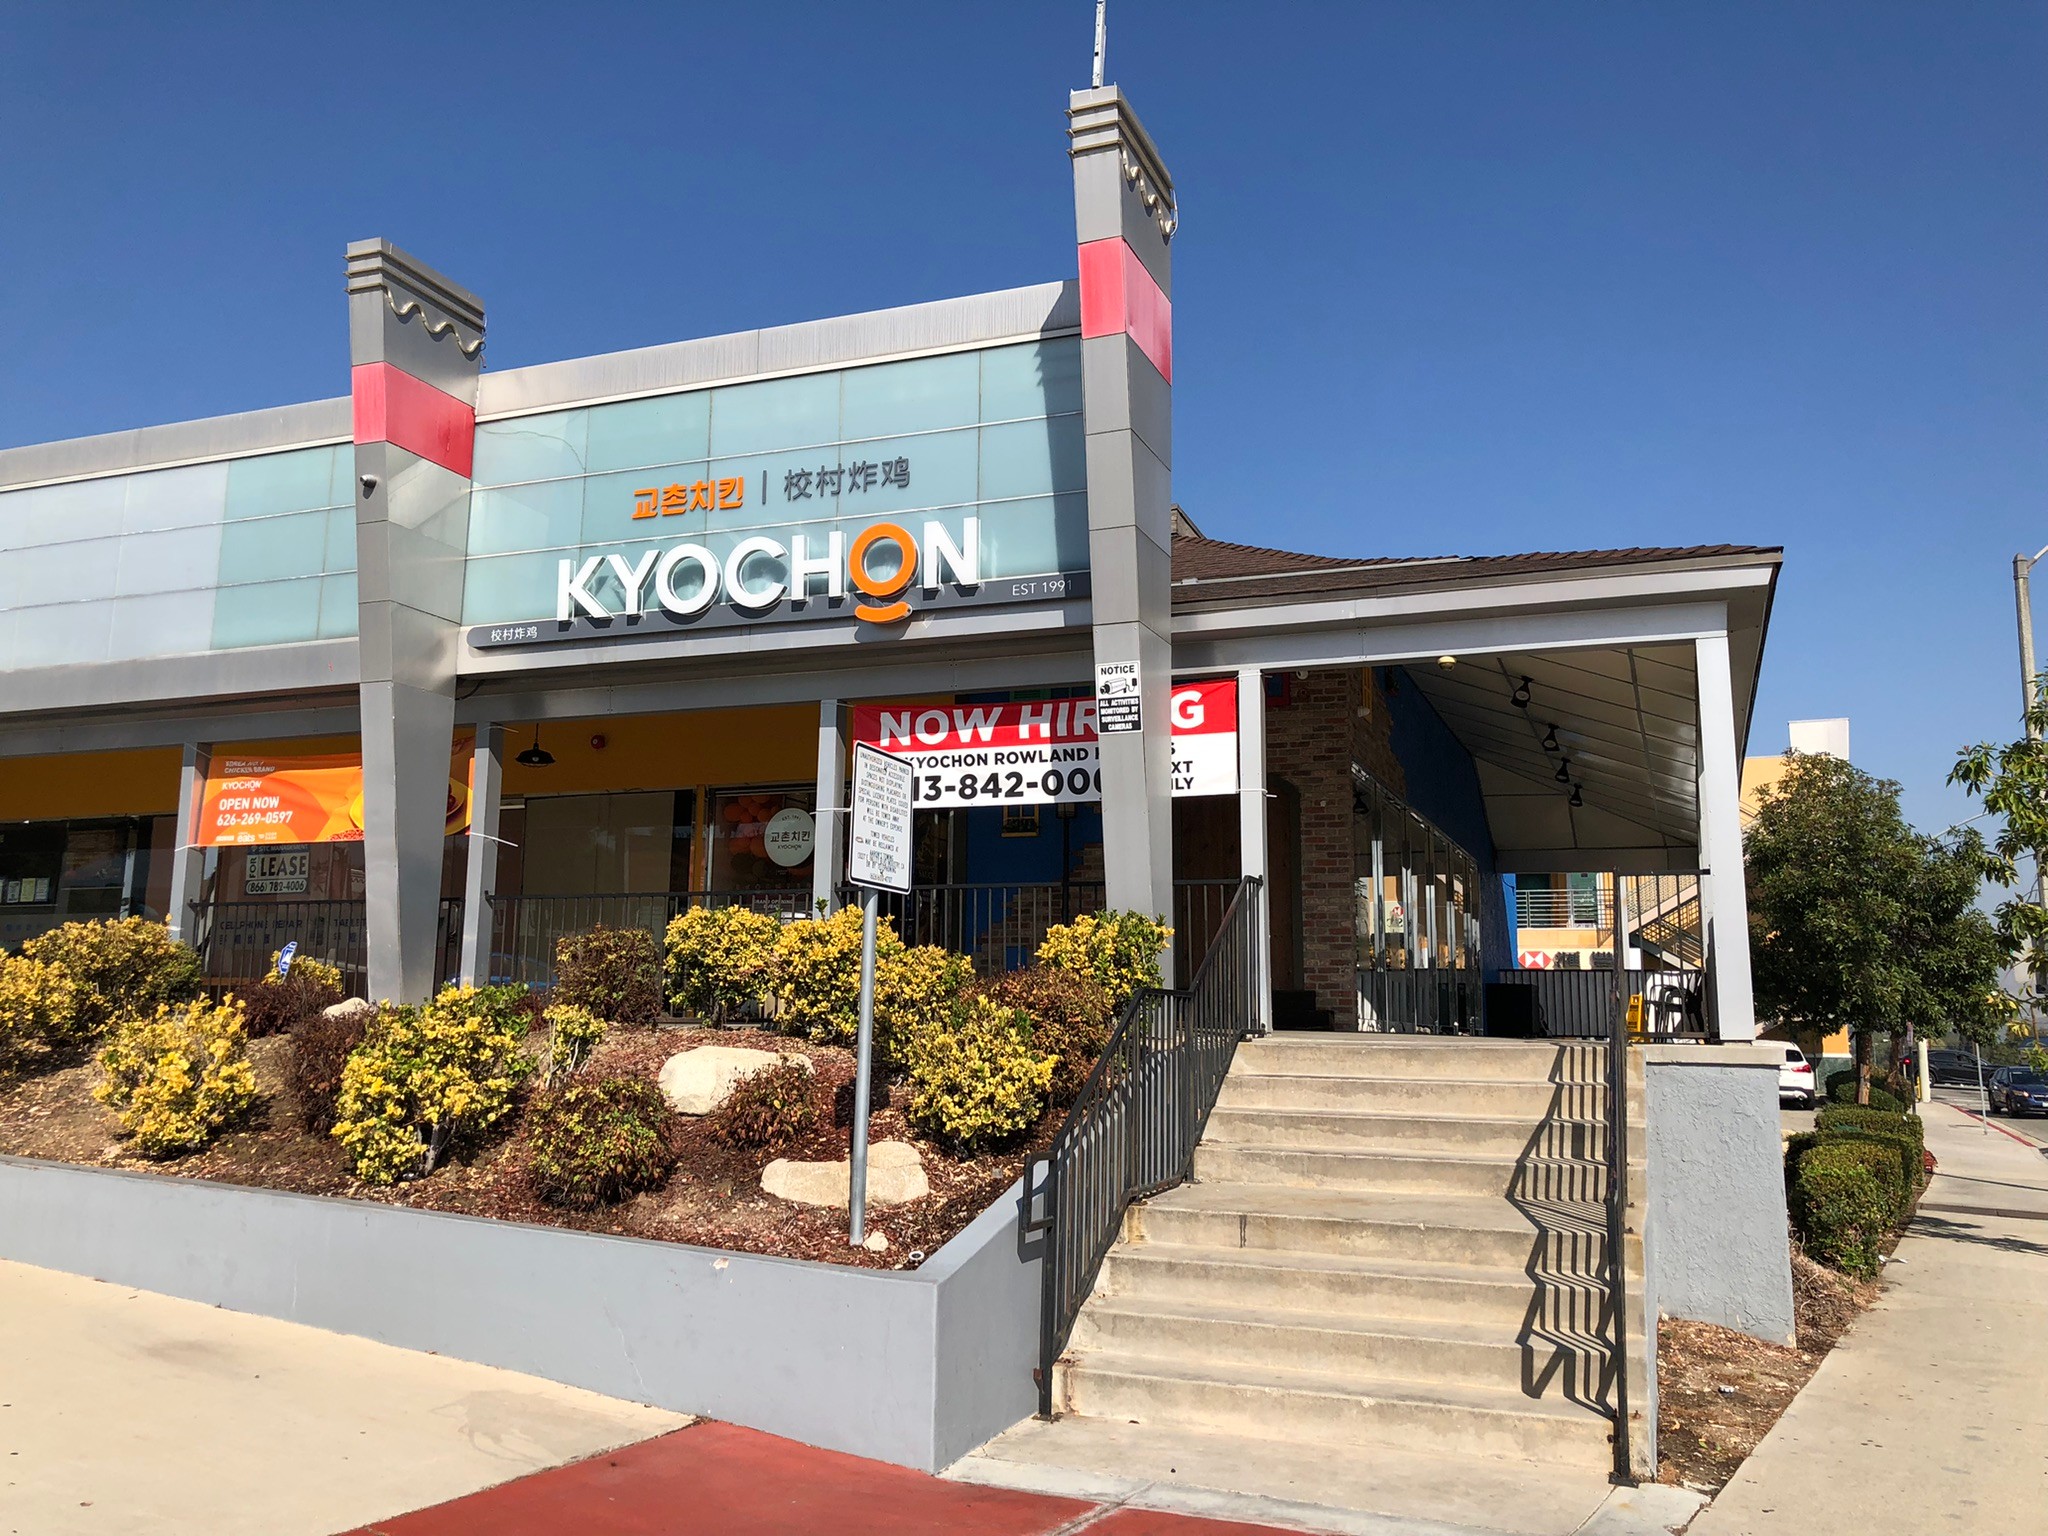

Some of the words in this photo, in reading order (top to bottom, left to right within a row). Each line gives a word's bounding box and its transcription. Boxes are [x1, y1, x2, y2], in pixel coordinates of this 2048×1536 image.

[784, 456, 910, 501] 校村炸鸡
[632, 476, 744, 519] 교촌치킨
[556, 516, 981, 623] KYOCHON
[1012, 583, 1037, 596] EST
[1042, 580, 1072, 593] 1991
[491, 626, 538, 642] 校村炸鸡
[1101, 665, 1135, 675] NOTICE
[1111, 698, 1139, 706] ACTIVITIES
[880, 706, 1003, 747] NOW
[1018, 690, 1205, 742] HIRG
[1101, 706, 1130, 715] MONITORED
[1101, 714, 1139, 723] SURVEILLANCE
[1108, 722, 1133, 731] CAMERAS
[905, 752, 988, 769] YOCHON
[994, 748, 1089, 766] ROWLAND
[222, 780, 262, 792] KYOCHON
[913, 768, 1102, 802] 13-842-00
[219, 797, 250, 811] OPEN
[252, 796, 279, 809] NOW
[217, 810, 293, 827] 626-269-0597
[770, 831, 810, 842] 교촌치킨
[249, 857, 257, 878] FOR
[260, 856, 306, 876] LEASE
[248, 882, 267, 892] (866)
[270, 881, 304, 891] 782-4006
